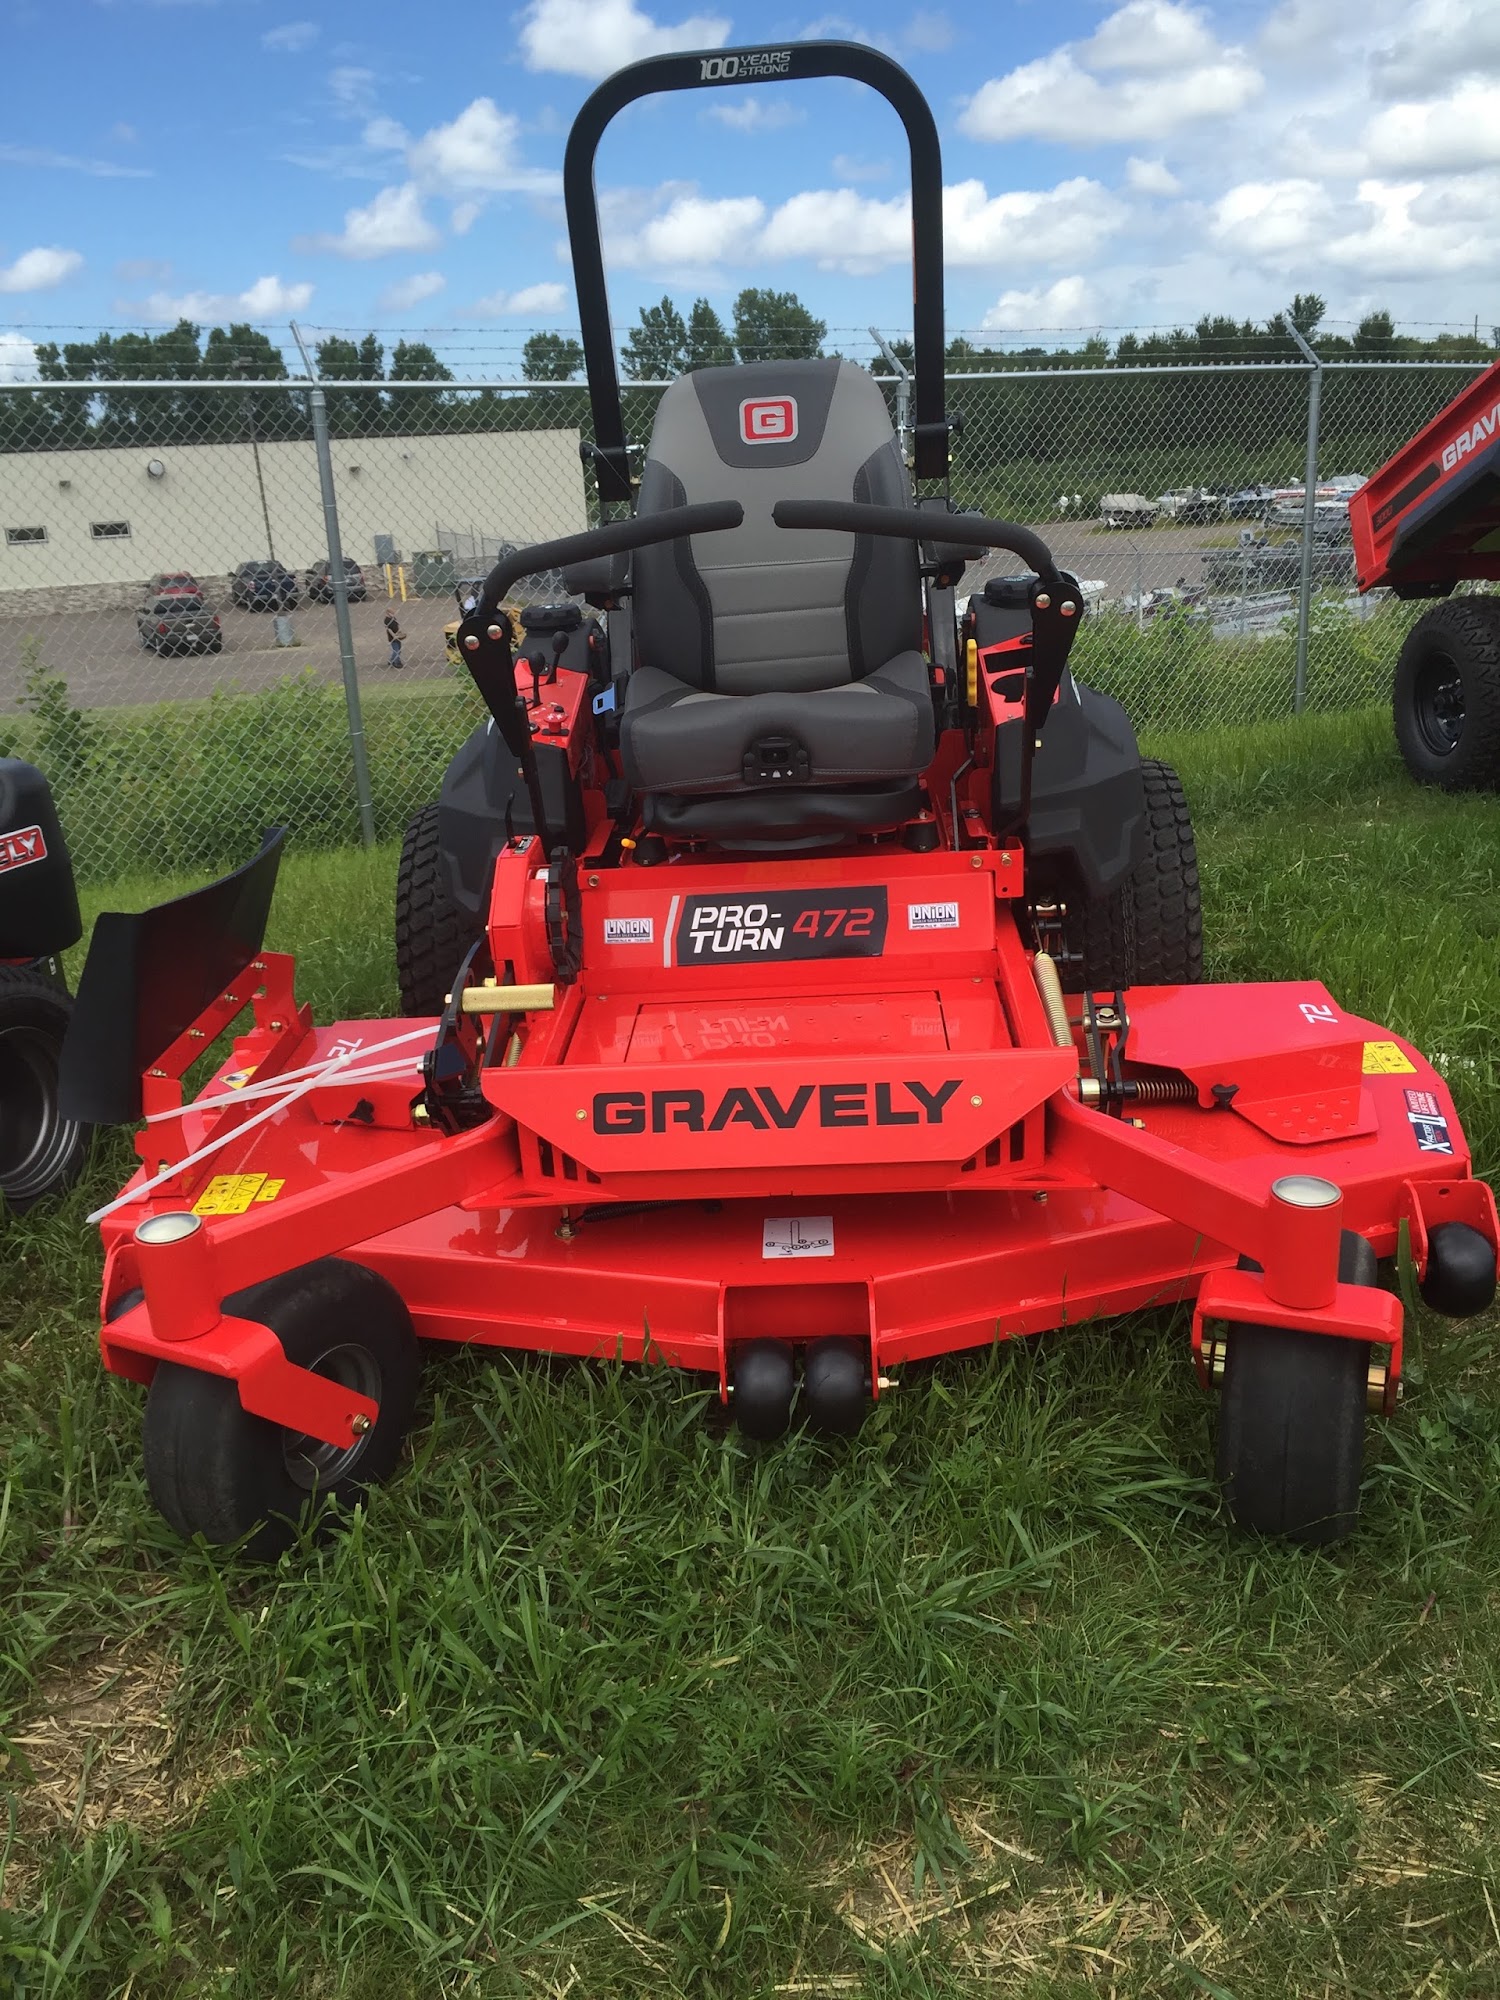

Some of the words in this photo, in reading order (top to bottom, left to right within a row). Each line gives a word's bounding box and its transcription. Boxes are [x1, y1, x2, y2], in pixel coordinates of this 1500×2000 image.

[700, 56, 739, 80] 100
[740, 51, 792, 65] YEARS
[738, 64, 789, 77] STRONG
[690, 903, 782, 930] PRO-
[792, 907, 876, 938] 472
[689, 926, 785, 954] TURN
[1298, 1002, 1339, 1024] 72
[592, 1079, 963, 1136] GRAVELY
[1406, 1090, 1422, 1113] LIMITED
[1416, 1091, 1430, 1114] LIFETIME
[1422, 1124, 1435, 1143] FACTOR
